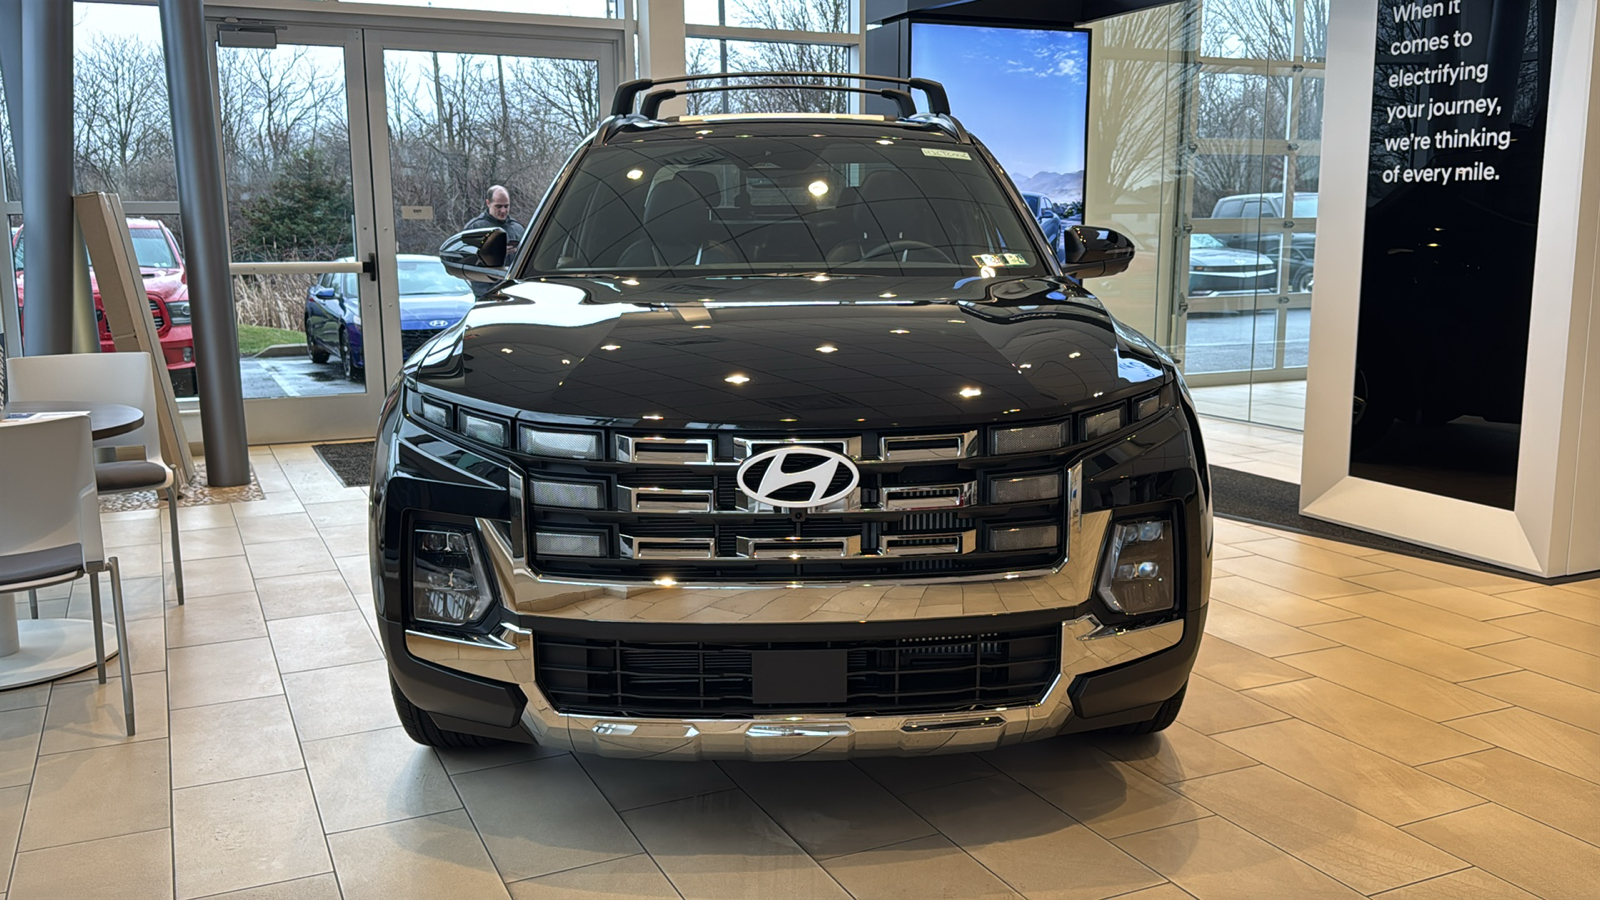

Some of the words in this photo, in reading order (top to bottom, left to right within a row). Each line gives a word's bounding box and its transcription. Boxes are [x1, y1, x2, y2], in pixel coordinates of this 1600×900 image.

[1393, 2, 1444, 23] When
[1448, 0, 1461, 15] it
[1390, 35, 1449, 55] comes
[1453, 30, 1473, 47] to
[1388, 61, 1489, 88] electrifying
[1386, 103, 1425, 124] your
[1427, 97, 1502, 121] journey,
[1385, 133, 1431, 151] we're
[1434, 127, 1511, 150] thinking
[1382, 165, 1401, 183] of
[1402, 166, 1452, 186] every
[1454, 162, 1500, 181] mile.
